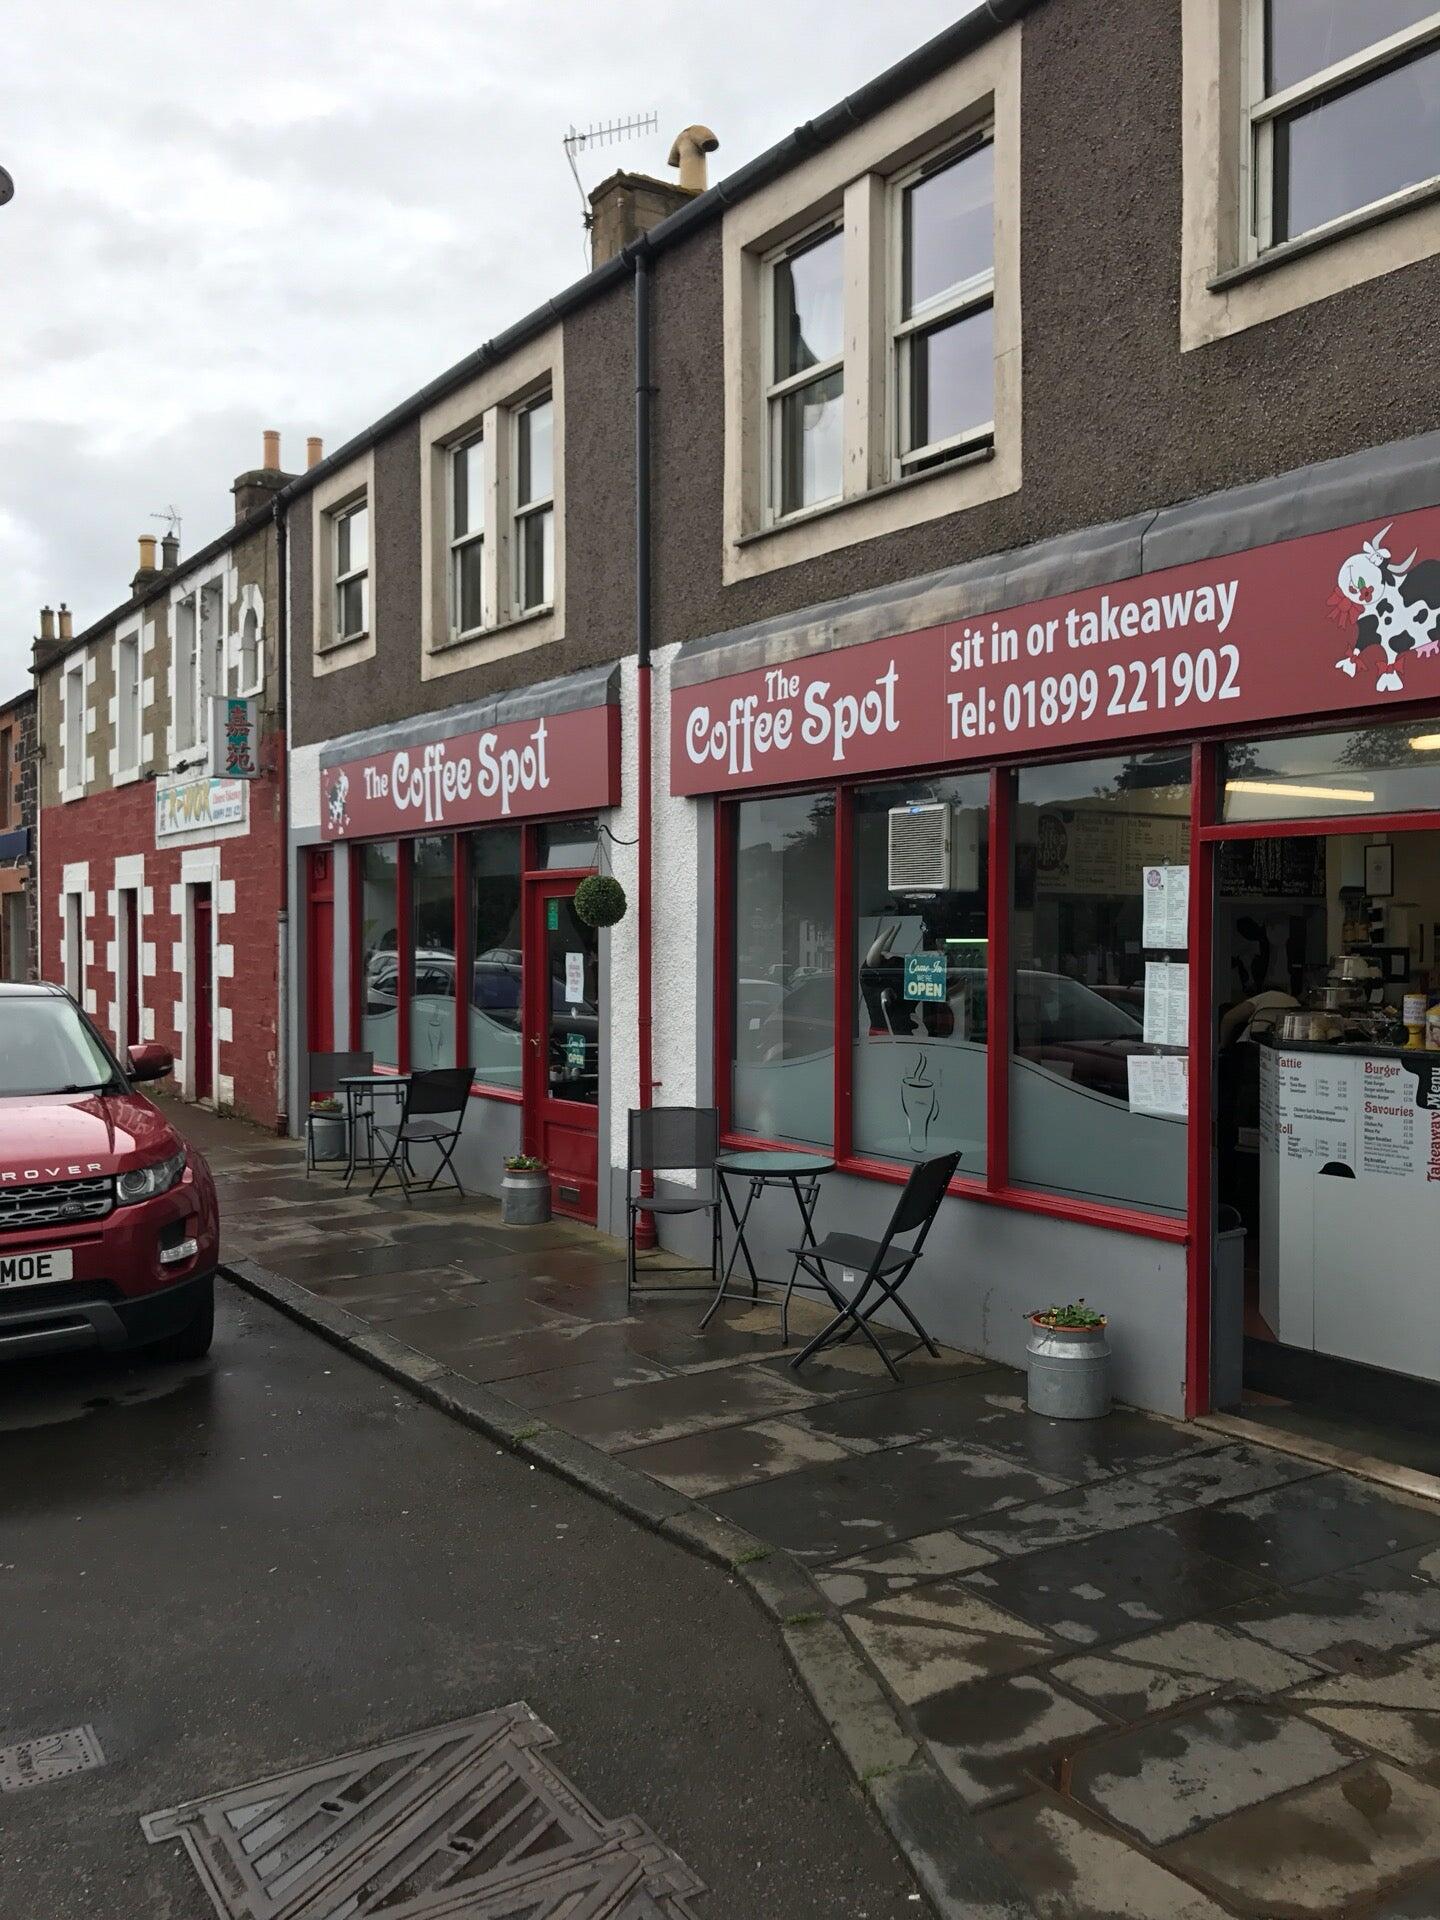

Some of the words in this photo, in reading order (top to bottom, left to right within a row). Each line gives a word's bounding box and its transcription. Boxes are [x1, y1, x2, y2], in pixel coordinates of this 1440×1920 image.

[949, 628, 985, 673] sit
[991, 622, 1019, 665] in
[1026, 619, 1060, 657] or
[1064, 579, 1239, 649] takeaway
[763, 668, 801, 703] The
[946, 686, 997, 740] Tel:
[1002, 669, 1099, 732] 01899
[1106, 643, 1241, 717] 221902
[685, 694, 793, 775] Coffee
[800, 658, 901, 762] Spot
[362, 765, 390, 801] The
[390, 742, 473, 823] Coffee
[476, 716, 551, 816] Spot
[909, 958, 931, 975] Come
[931, 960, 944, 974] In
[907, 981, 943, 997] OPEN
[1364, 1061, 1401, 1078] Burger
[1426, 1066, 1440, 1110] Menu
[1364, 1101, 1415, 1118] Savouries
[1427, 1111, 1440, 1183] Takeaway
[1, 1163, 102, 1181] ROVER
[0, 1254, 53, 1284] MOE
